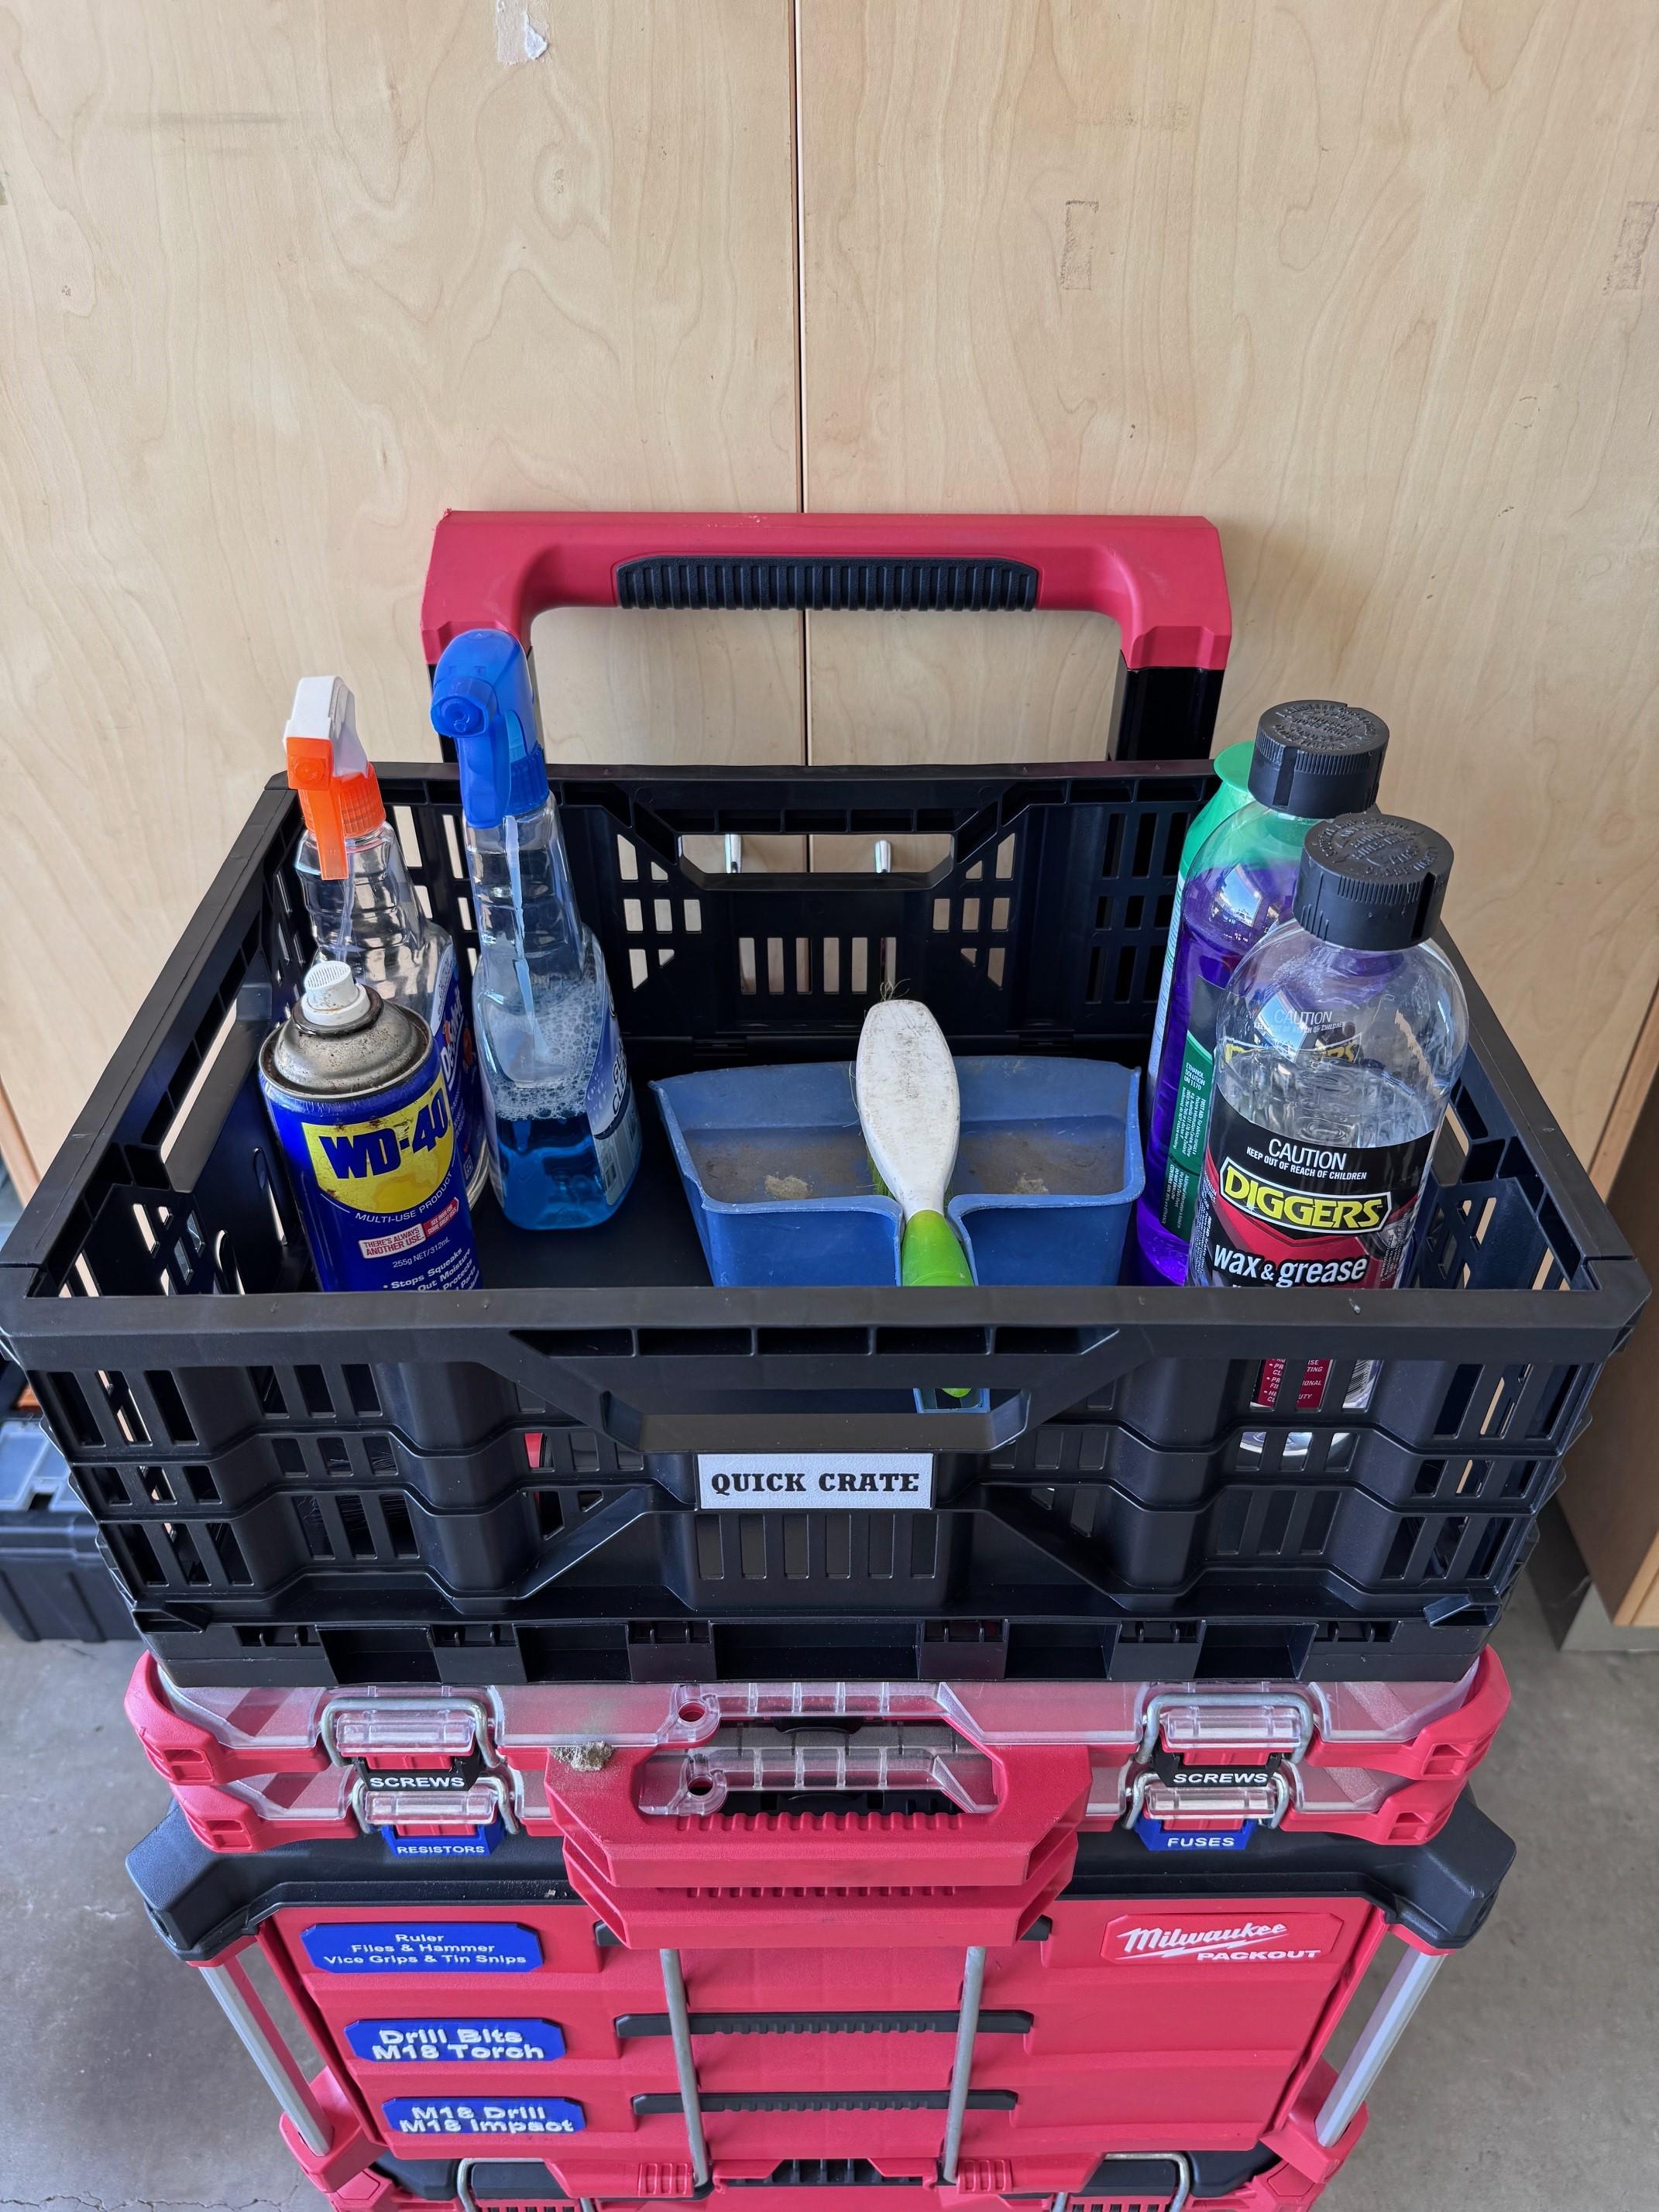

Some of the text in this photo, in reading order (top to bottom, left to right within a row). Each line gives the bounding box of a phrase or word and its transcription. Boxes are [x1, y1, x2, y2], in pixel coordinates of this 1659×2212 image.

[318, 1088, 448, 1179] WD-40
[1269, 1139, 1347, 1170] CAUTION
[1246, 1146, 1367, 1180] KEEP OUT OF REACH OF CHILDREN
[355, 1172, 452, 1223] MULTI-USE PRODUCT
[1224, 1166, 1382, 1228] DIGGERS
[364, 1227, 420, 1249] THERE'S ALWAYS
[366, 1242, 405, 1256] ANOTHER
[390, 1247, 462, 1290] Stops Squeaks
[392, 1256, 413, 1268] 255g
[417, 1279, 438, 1292] Out
[439, 1248, 471, 1283] Moisture
[1214, 1244, 1367, 1288] wax & grease
[711, 1473, 919, 1496] QUICK CRATE
[369, 1777, 465, 1788] SCREWS
[1173, 1773, 1268, 1784] SCREWS
[397, 1846, 486, 1854] RESISTORS
[1167, 1837, 1235, 1847] FUSES
[395, 1934, 445, 1942] Ruler
[1117, 1922, 1288, 1953] Milwaukee
[351, 1944, 395, 1953] Files
[419, 1944, 495, 1953] Hammer
[1197, 1949, 1321, 1961] PACKOUT
[324, 1955, 527, 1966] Vice Grips & Tin Snips
[379, 2028, 523, 2045] Drill Bits
[372, 2044, 544, 2060] M18 Torch
[411, 2107, 545, 2119] M18 Drill
[399, 2119, 575, 2134] M18 Impact
